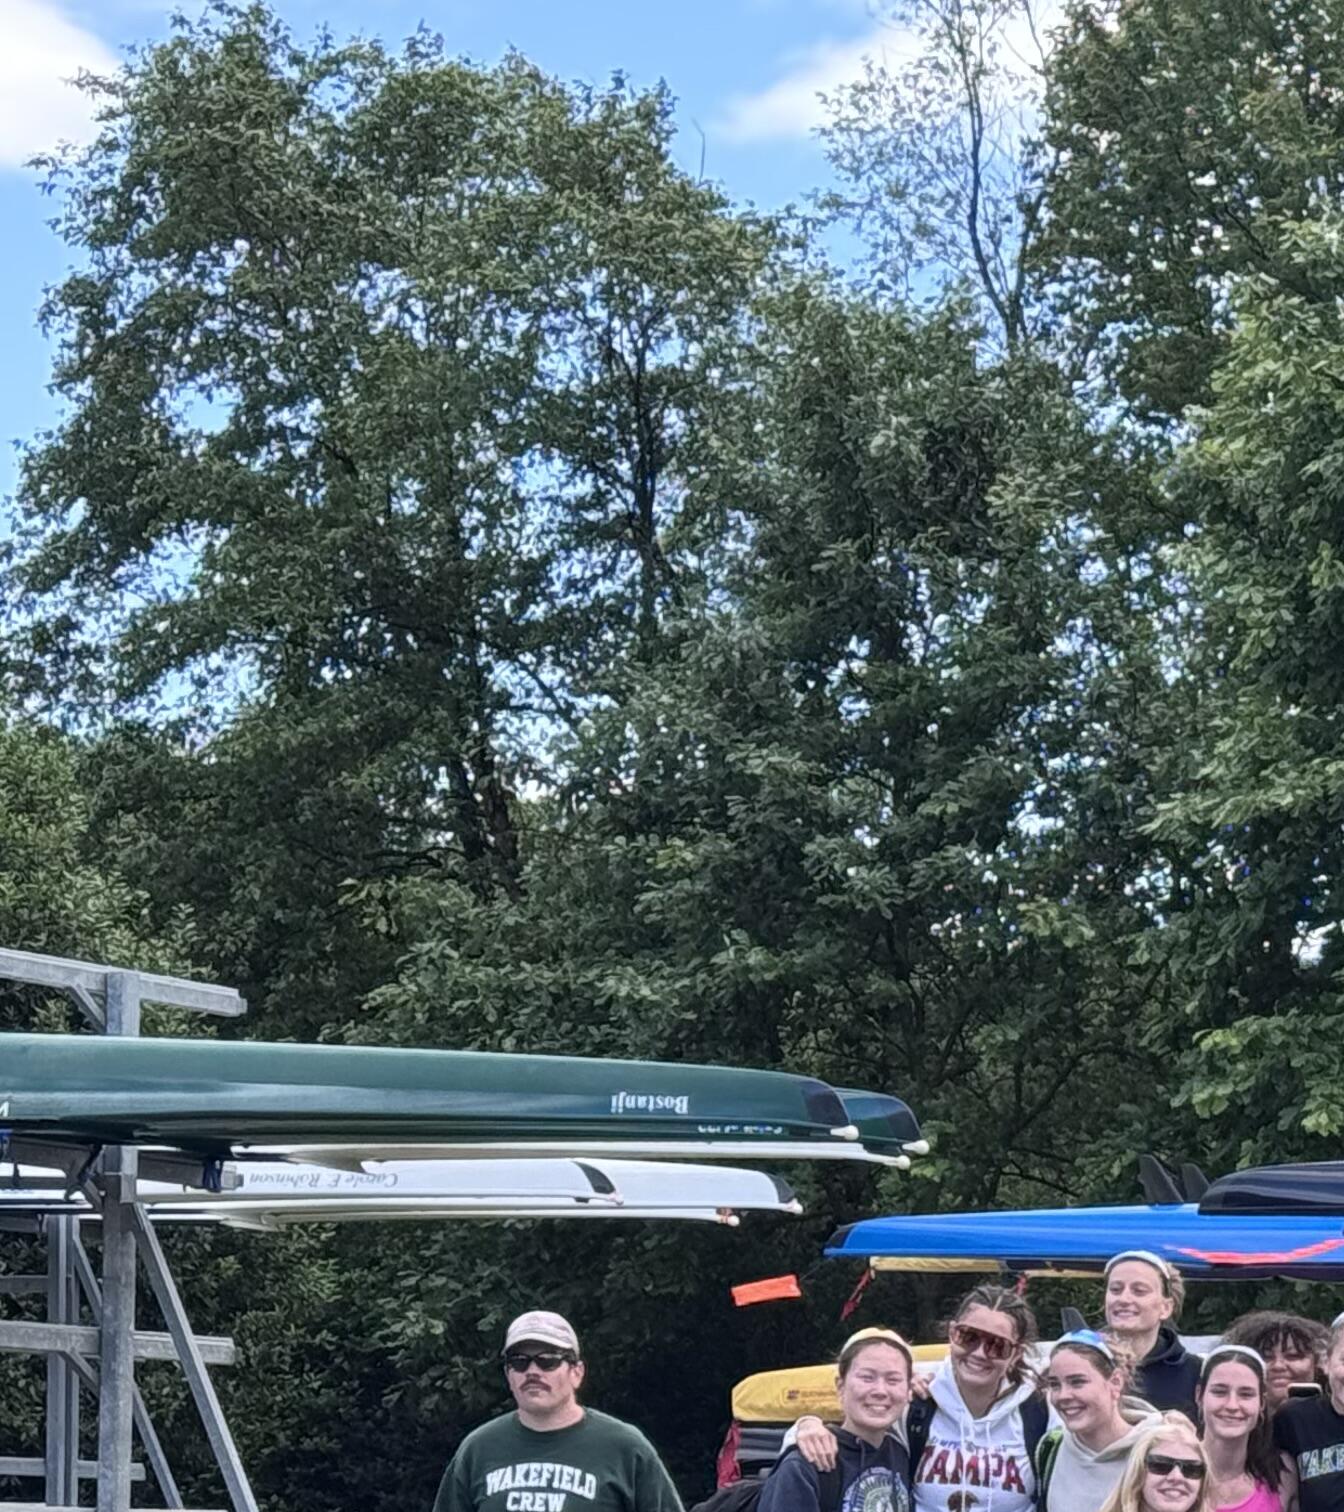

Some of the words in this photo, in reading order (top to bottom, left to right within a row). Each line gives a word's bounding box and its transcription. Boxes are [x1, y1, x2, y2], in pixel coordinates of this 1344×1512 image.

[610, 1092, 689, 1114] Bostanji
[250, 1172, 320, 1188] Robinson
[915, 1445, 1026, 1494] TAMPA
[486, 1462, 597, 1500] WAKEFIELD
[506, 1491, 567, 1512] CREW
